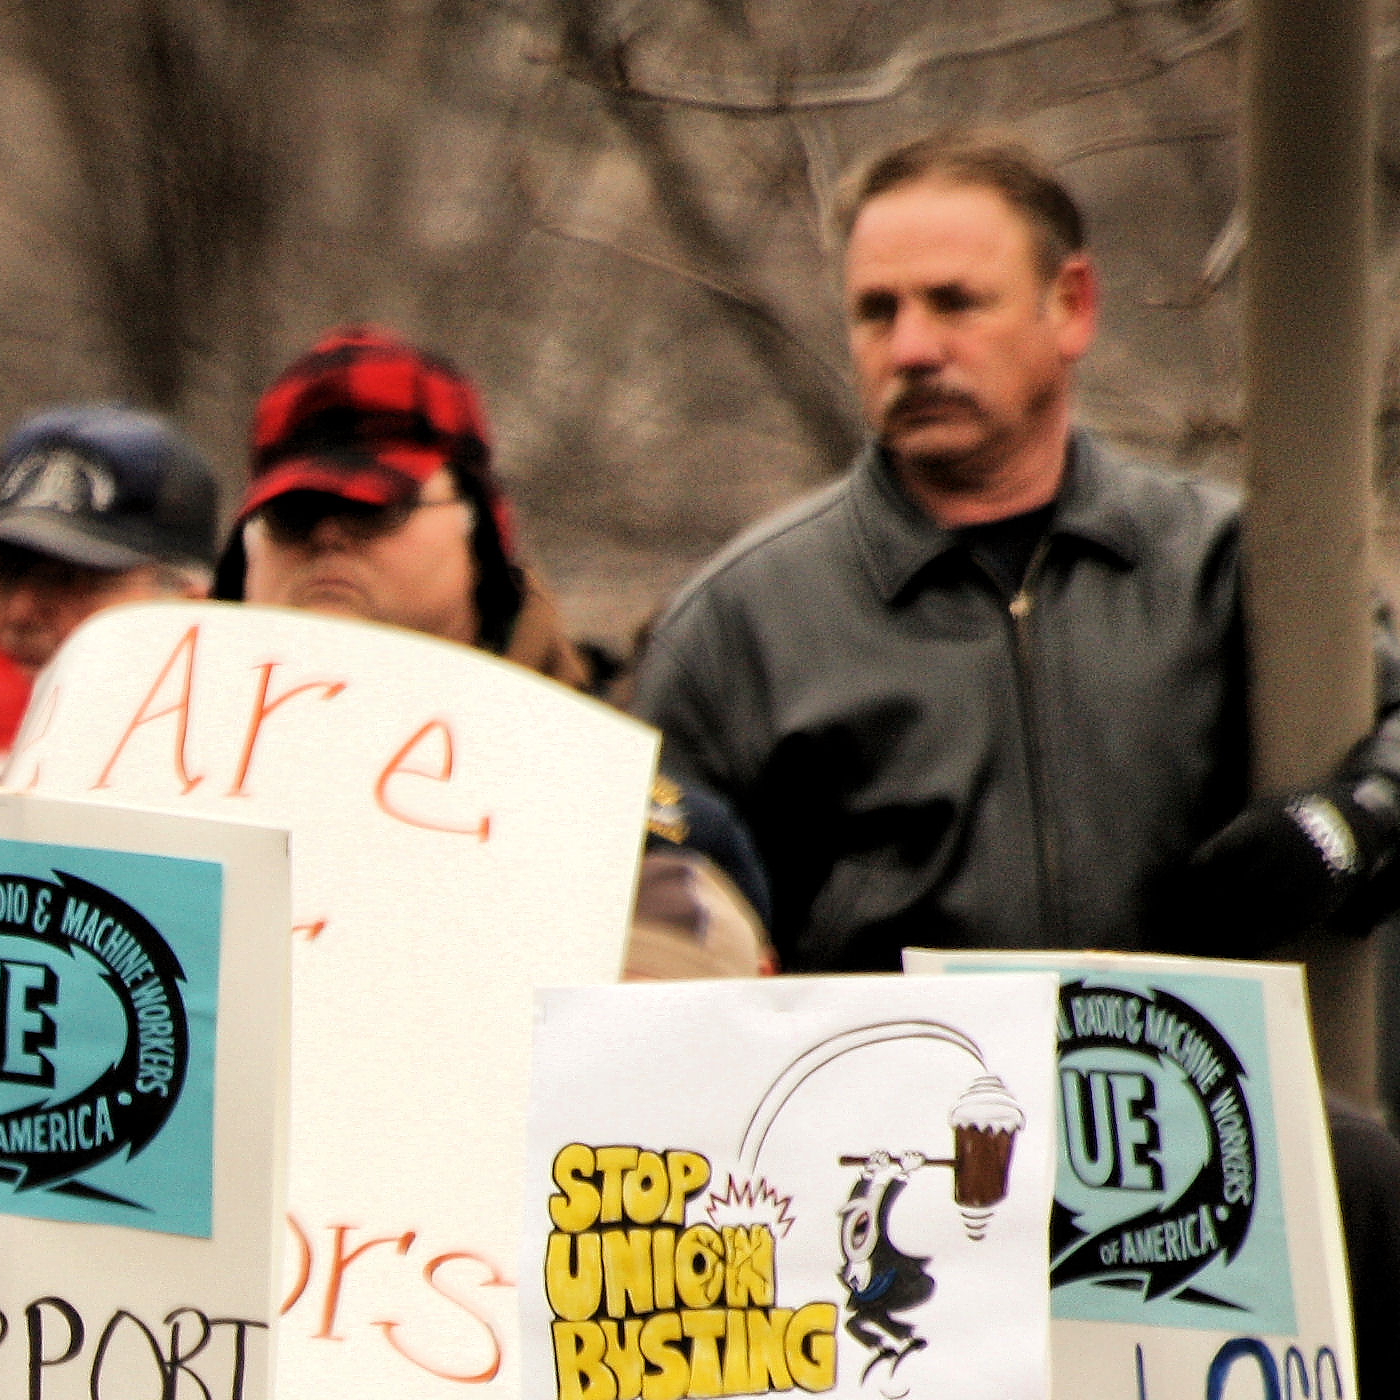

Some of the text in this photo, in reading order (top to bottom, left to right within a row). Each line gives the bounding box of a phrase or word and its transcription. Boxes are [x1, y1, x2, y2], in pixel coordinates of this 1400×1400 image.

[88, 625, 491, 843] Are
[33, 887, 53, 934] &
[61, 897, 152, 989] MACHINE
[133, 970, 175, 1099] WORKERS
[1060, 1068, 1166, 1193] UE
[1144, 1004, 1226, 1096] MACHINE
[1210, 1086, 1252, 1207] WORKERS
[547, 1141, 712, 1235] STOP
[1122, 1204, 1220, 1265] AMERICA
[543, 1224, 779, 1320] UNION
